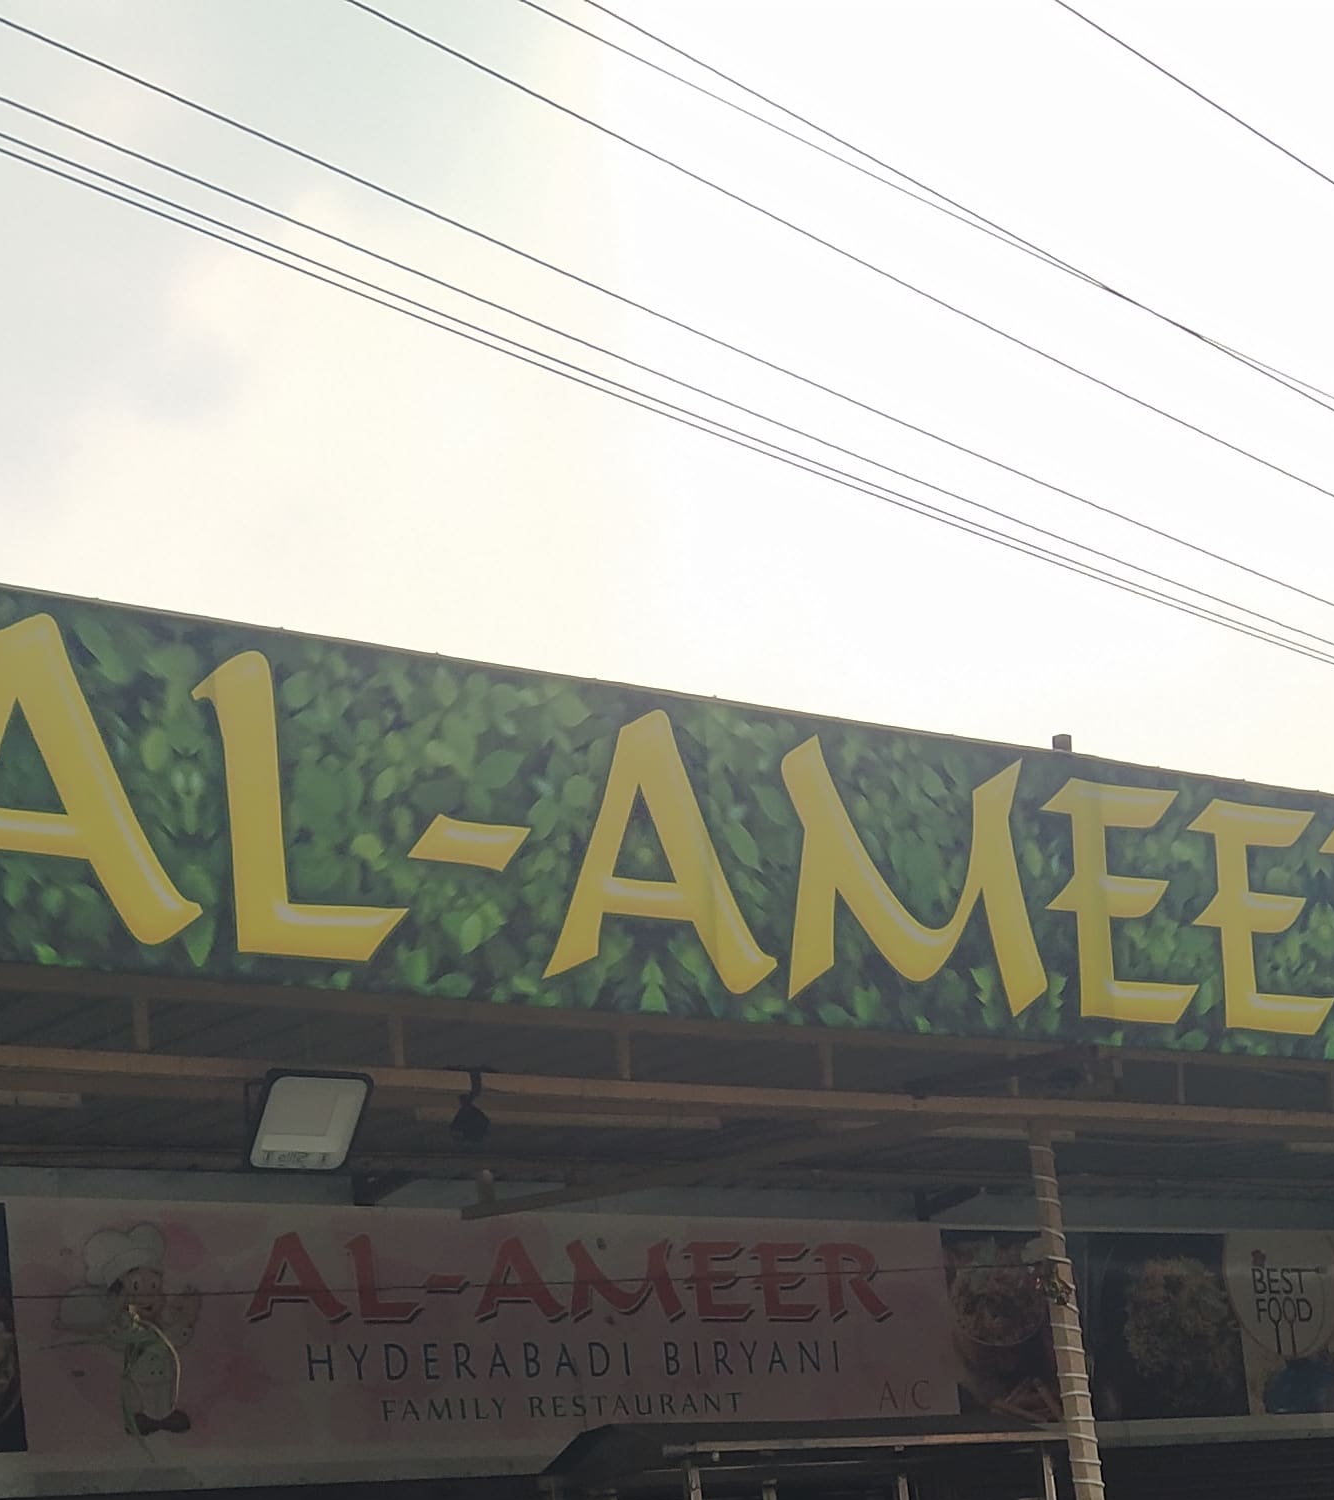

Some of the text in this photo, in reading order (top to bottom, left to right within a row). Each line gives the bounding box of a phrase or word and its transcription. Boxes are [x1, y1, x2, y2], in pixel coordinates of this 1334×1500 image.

[245, 1231, 892, 1325] AL-AMEER
[1251, 1267, 1322, 1295] BEST
[1255, 1296, 1313, 1335] FOOD
[307, 1339, 842, 1383] HYDERABADI BIRYANI
[381, 1379, 932, 1424] FAMILY RESTAURANT A/C
